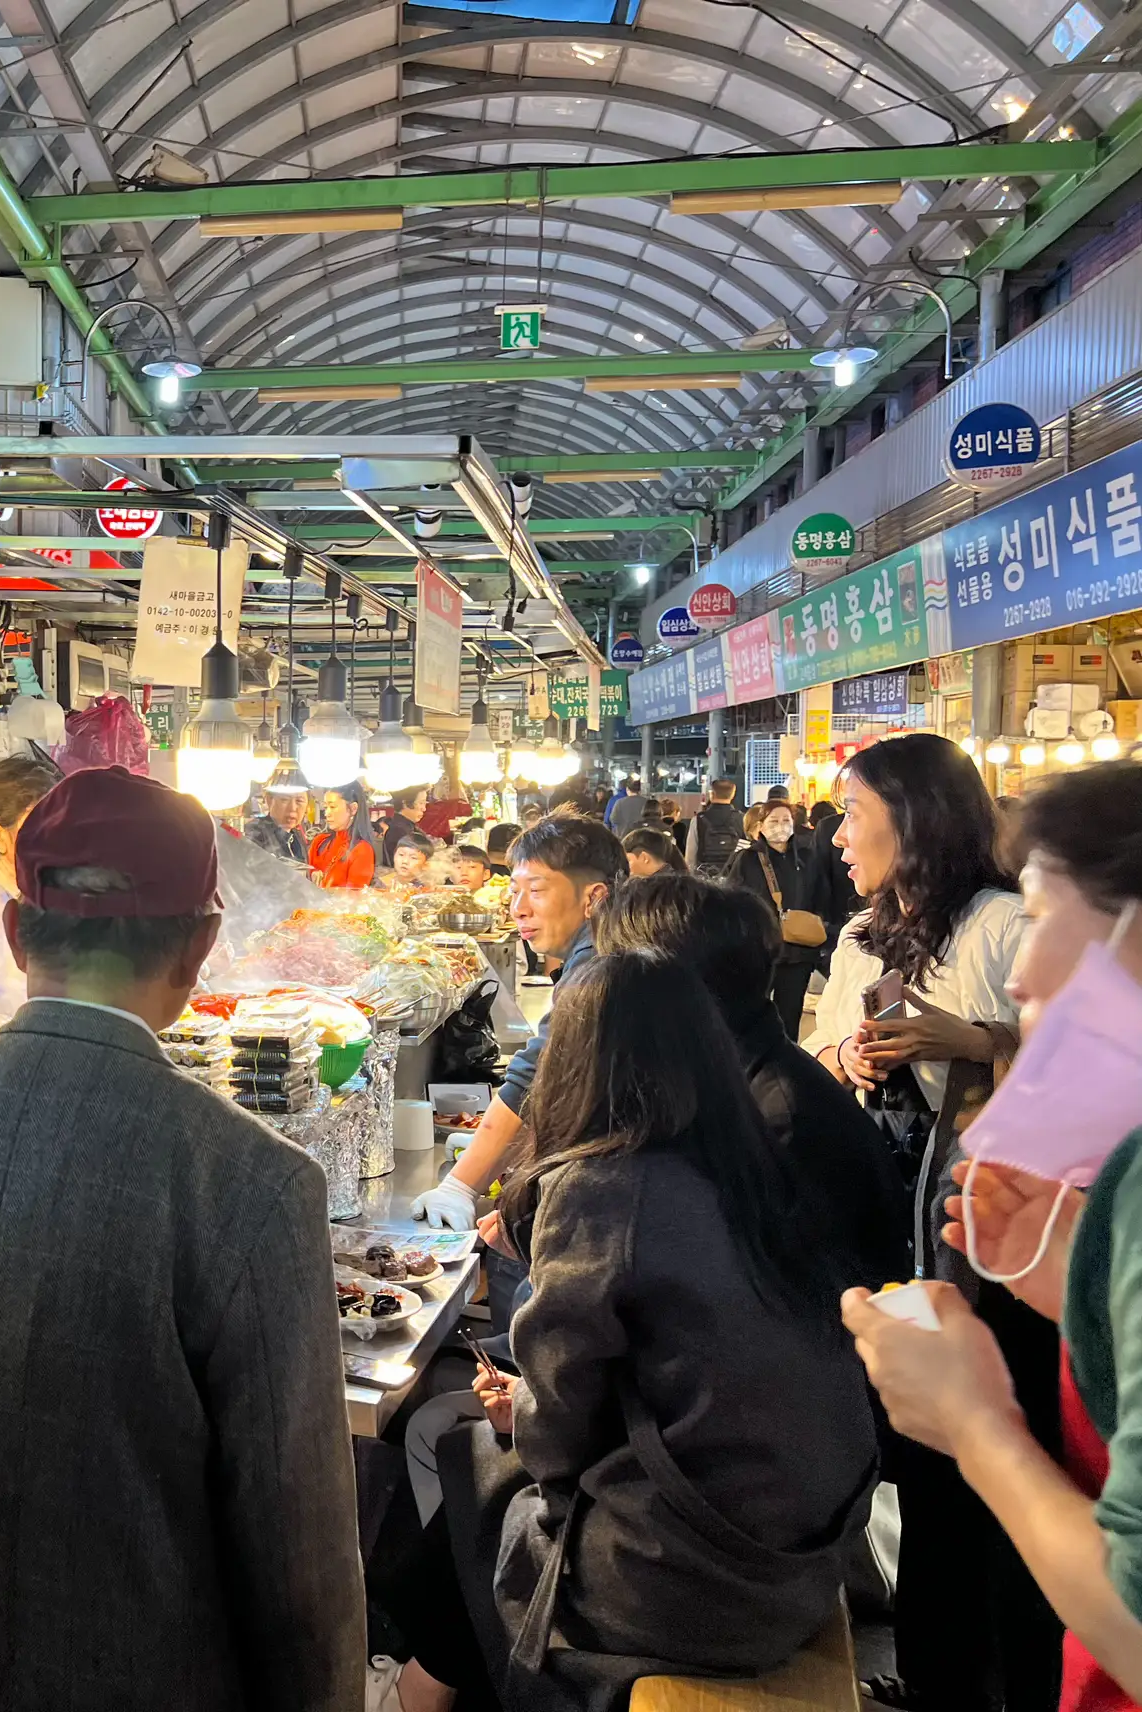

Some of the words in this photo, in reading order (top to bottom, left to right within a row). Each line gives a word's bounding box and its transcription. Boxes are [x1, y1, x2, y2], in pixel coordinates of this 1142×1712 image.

[955, 426, 1035, 459] 성미식품
[971, 465, 1022, 481] 2267-2928
[794, 530, 852, 551] 동명홍삼
[998, 472, 1142, 592] 성미식품
[953, 535, 990, 572] 식료품
[168, 590, 215, 602] 새마을금고
[692, 592, 731, 612] 신안상회
[957, 571, 993, 608] 선물용
[146, 606, 233, 619] 0142-10-00203-0
[800, 568, 894, 657] 동명홍삼
[1004, 596, 1052, 627] 2267-2928
[155, 623, 180, 634] 예금주
